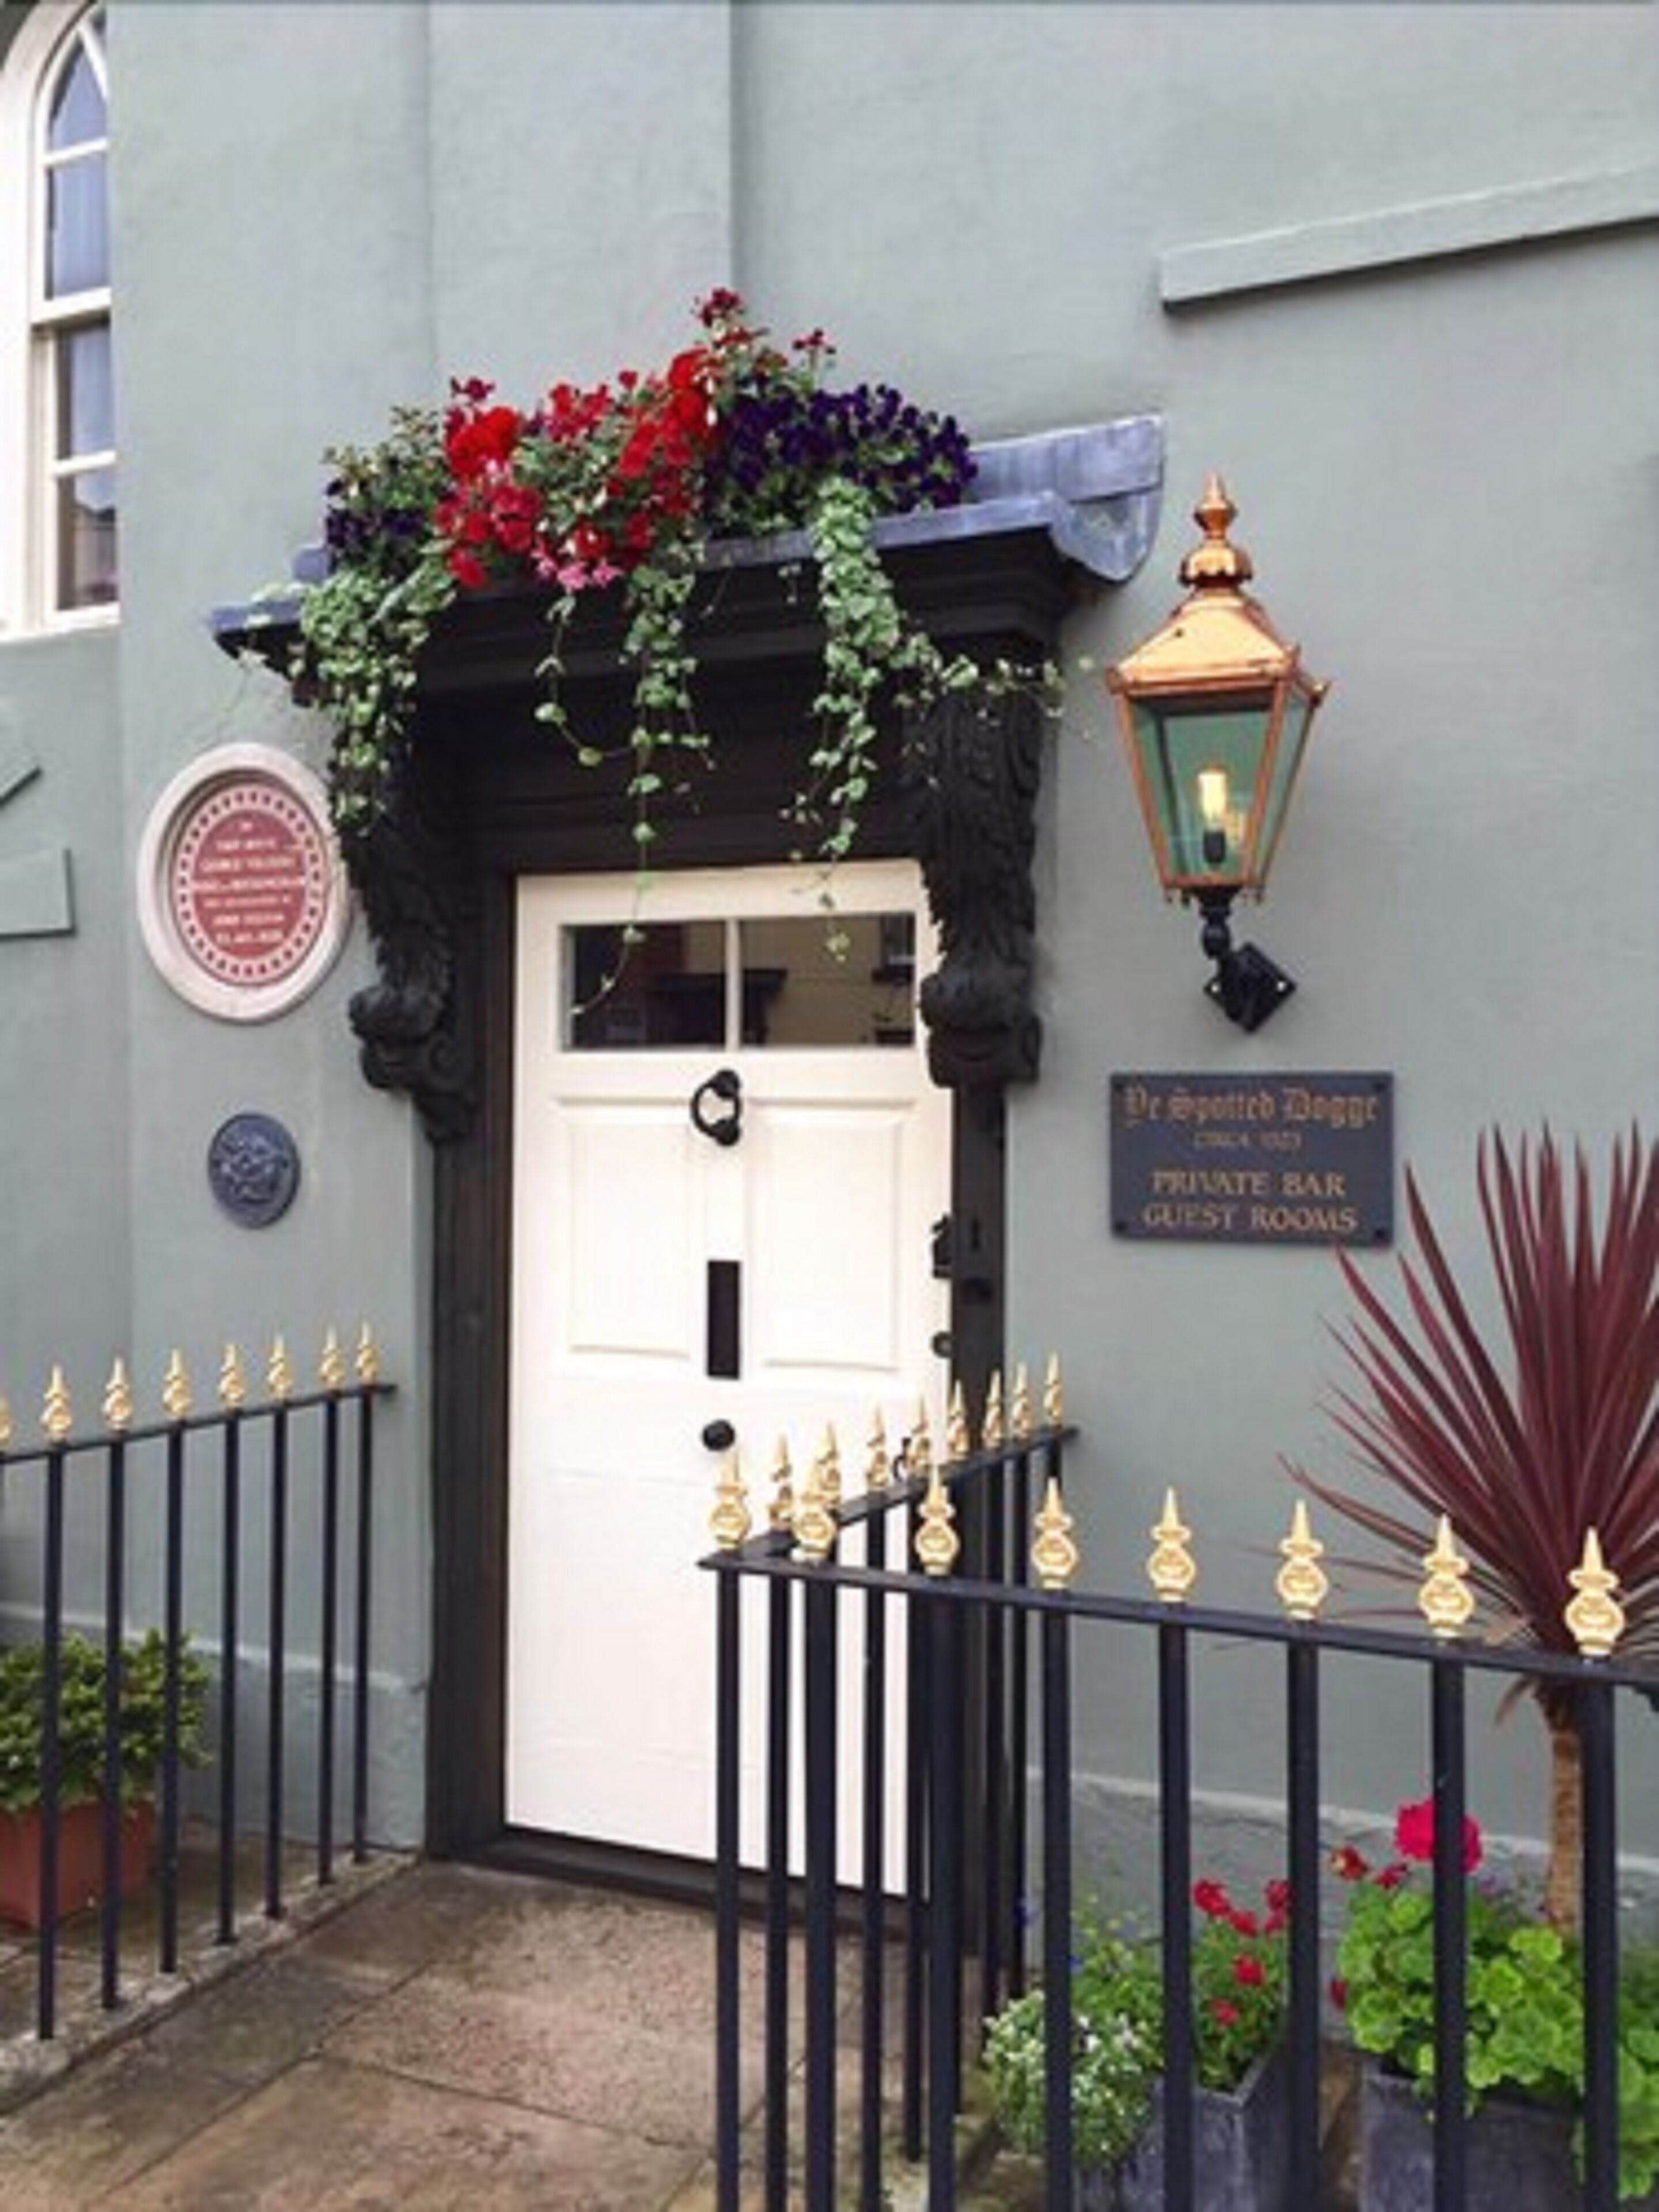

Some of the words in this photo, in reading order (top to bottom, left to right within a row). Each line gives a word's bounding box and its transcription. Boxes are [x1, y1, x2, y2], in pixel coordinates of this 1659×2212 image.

[1124, 1086, 1162, 1127] Ye
[1168, 1087, 1275, 1124] Spotted
[1152, 1171, 1270, 1196] PRIVATE
[1282, 1172, 1346, 1198] BAR
[1143, 1202, 1238, 1230] GUEST
[1251, 1205, 1358, 1233] ROOMS
